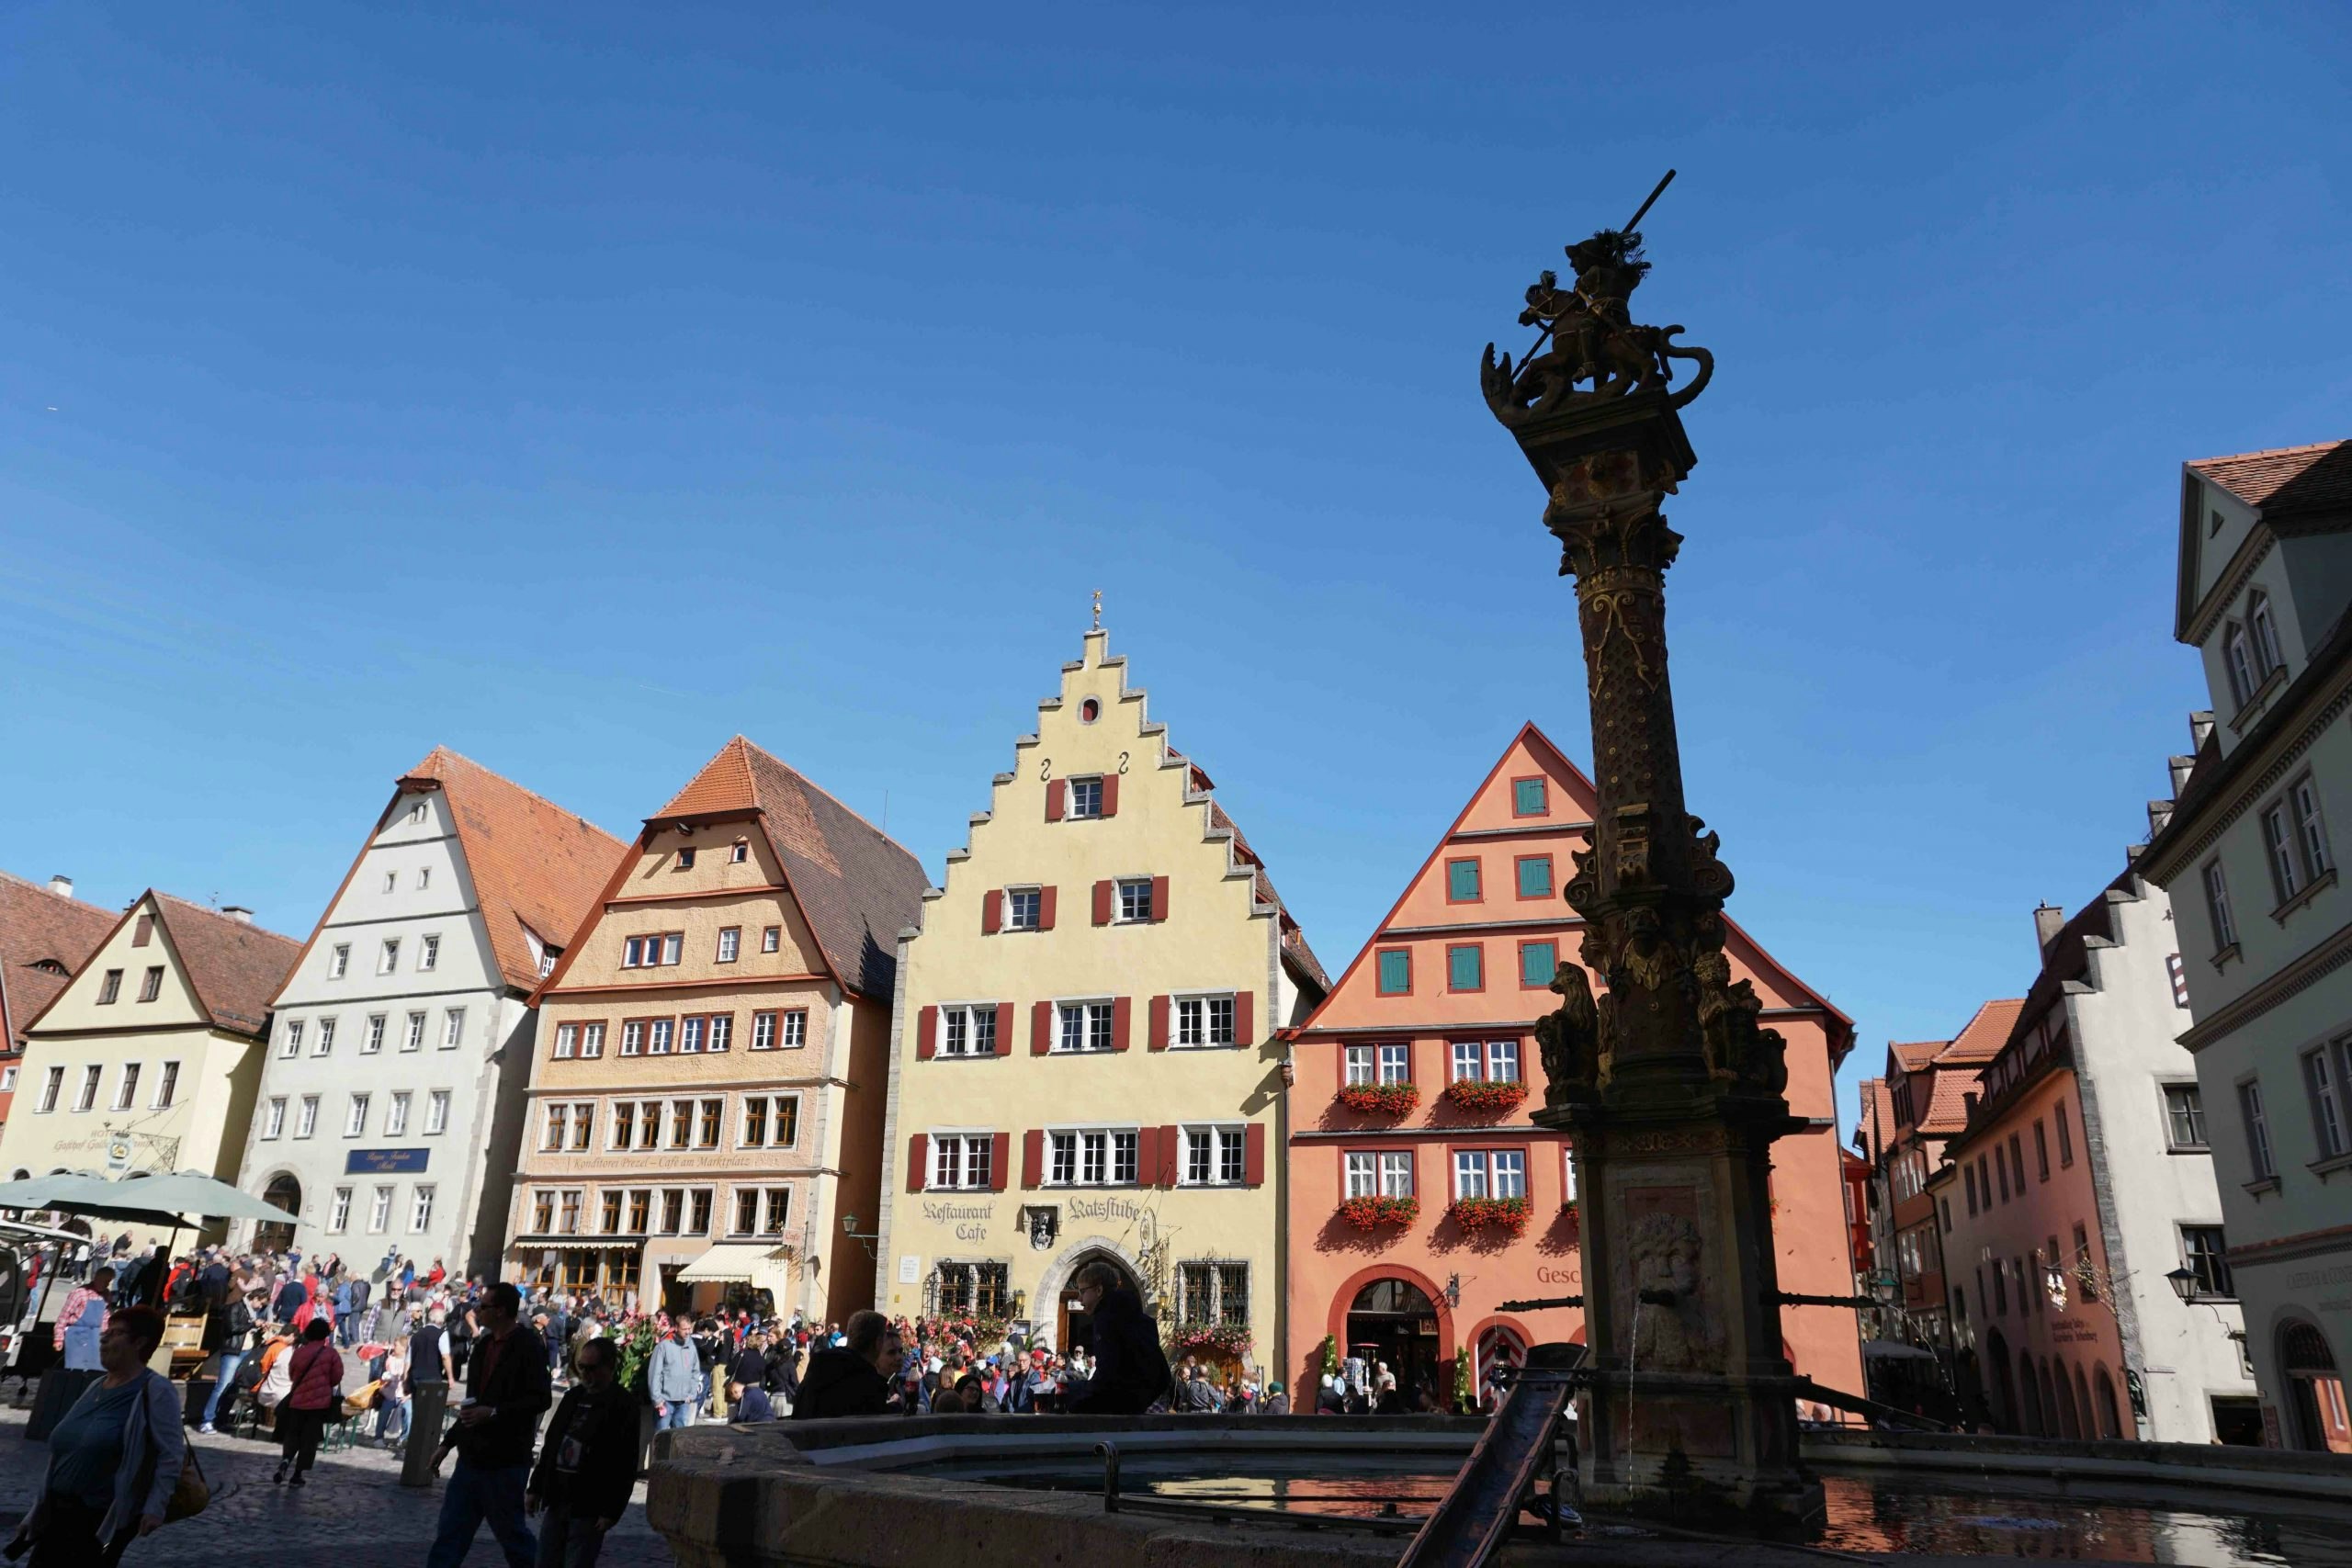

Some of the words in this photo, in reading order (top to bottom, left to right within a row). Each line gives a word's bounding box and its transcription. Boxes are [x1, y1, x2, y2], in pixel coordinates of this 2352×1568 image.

[573, 1156, 618, 1169] Konditorei
[696, 1155, 751, 1168] Marktplatz
[922, 1201, 995, 1224] Restaurant
